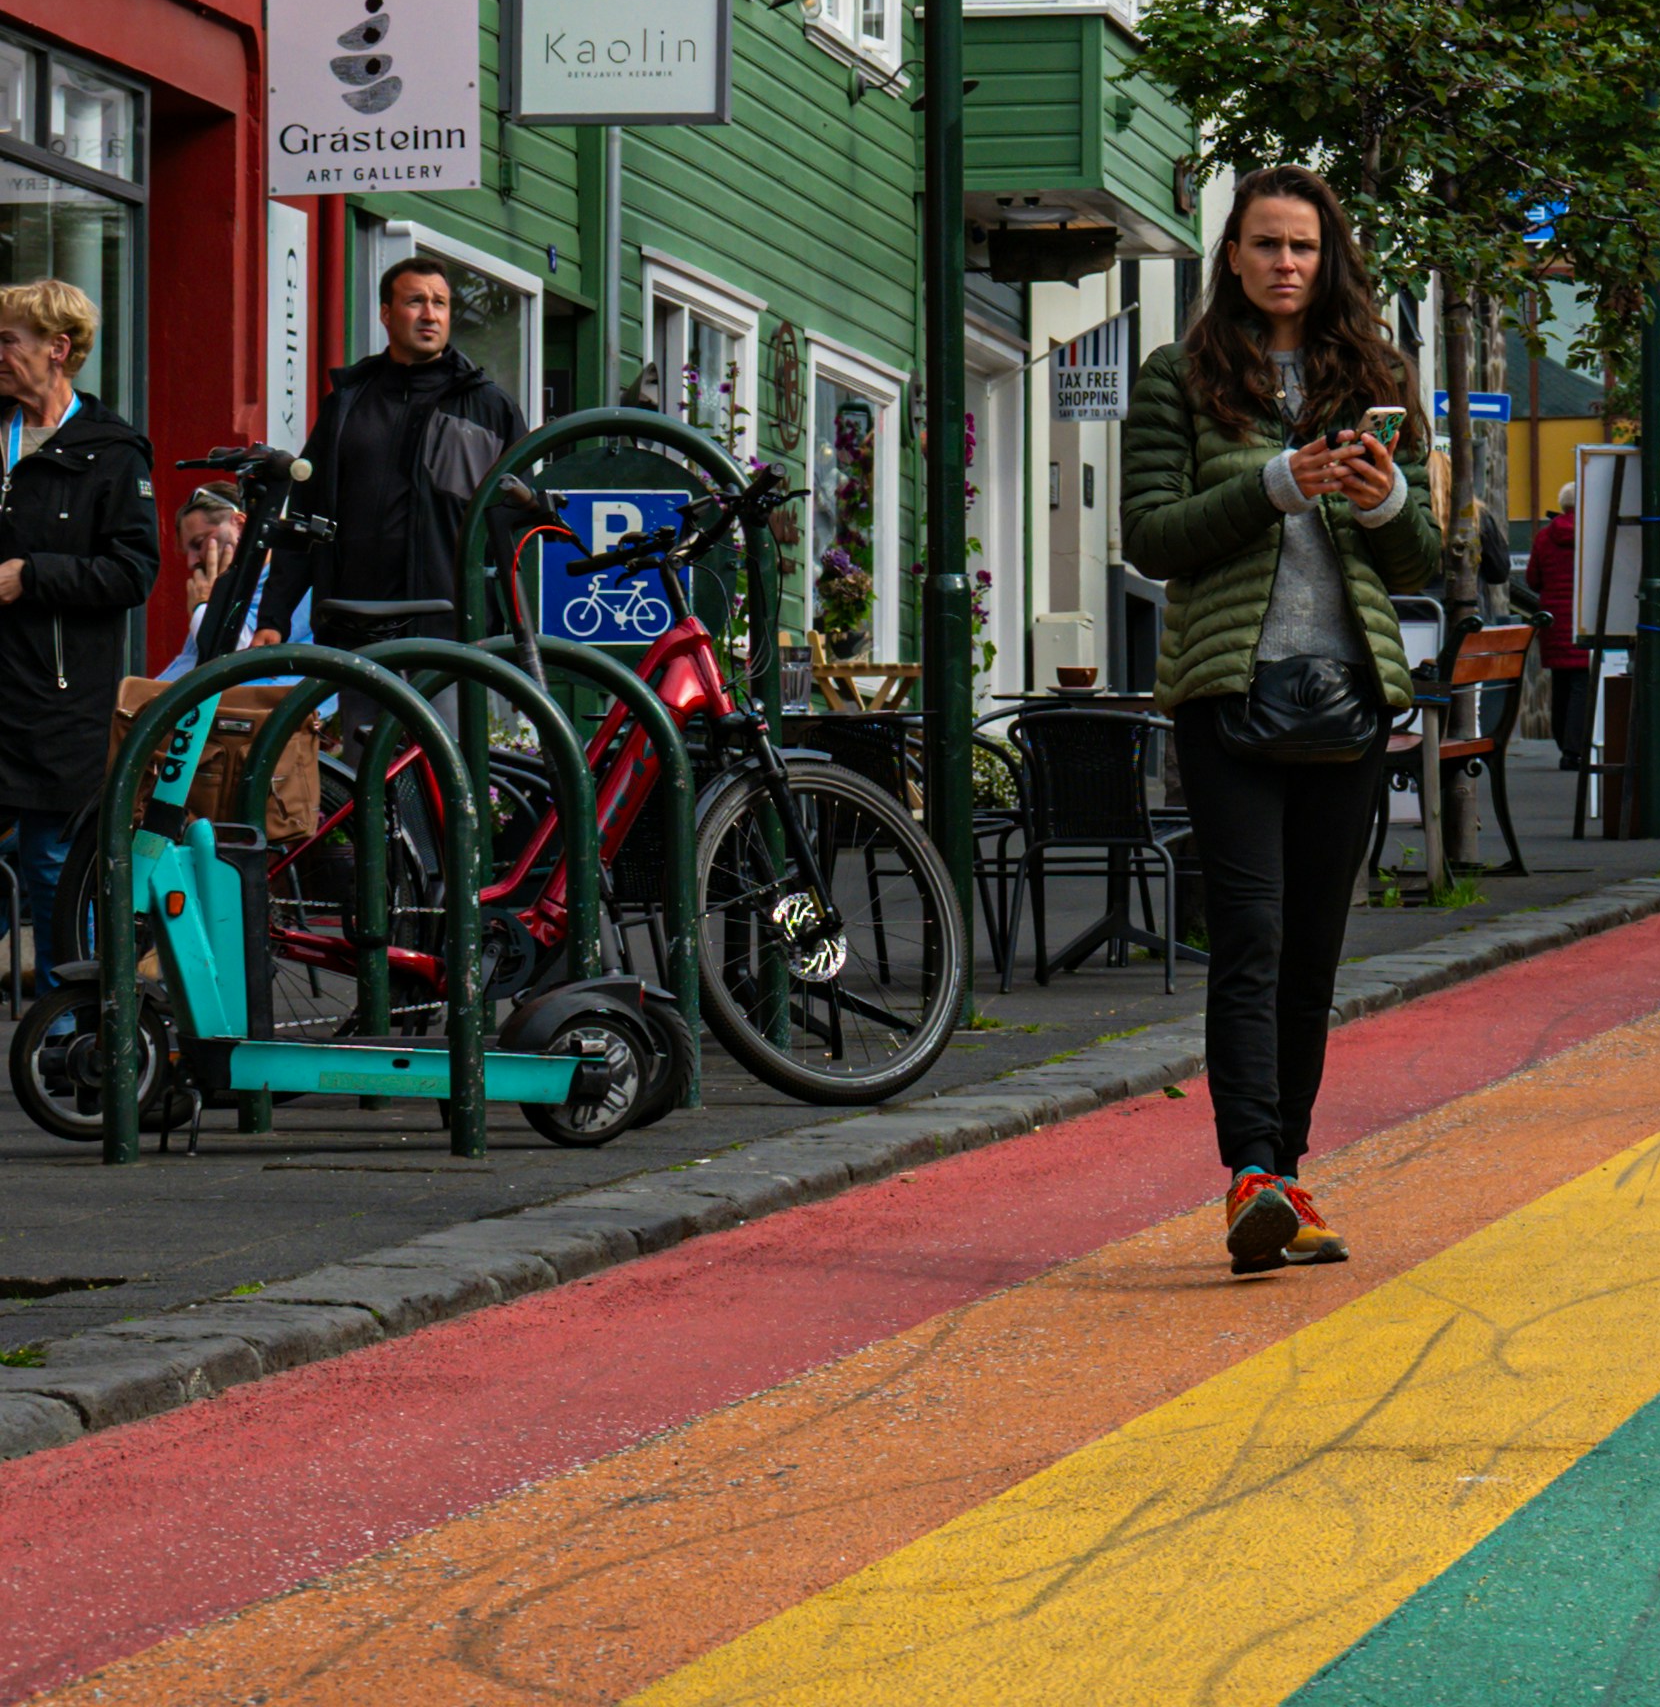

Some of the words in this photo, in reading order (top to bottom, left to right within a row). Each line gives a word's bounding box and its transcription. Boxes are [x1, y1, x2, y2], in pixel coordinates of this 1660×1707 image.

[545, 27, 696, 64] Kaolin
[279, 123, 466, 155] Grásteinn
[306, 168, 344, 183] ART
[353, 164, 443, 181] GALLERY
[281, 248, 298, 436] Gallery
[1058, 372, 1082, 388] TAX
[1087, 371, 1119, 388] FREE
[1058, 390, 1119, 406] SHOPPING
[1078, 408, 1088, 417] UP
[1091, 408, 1100, 417] TO
[592, 500, 644, 556] P
